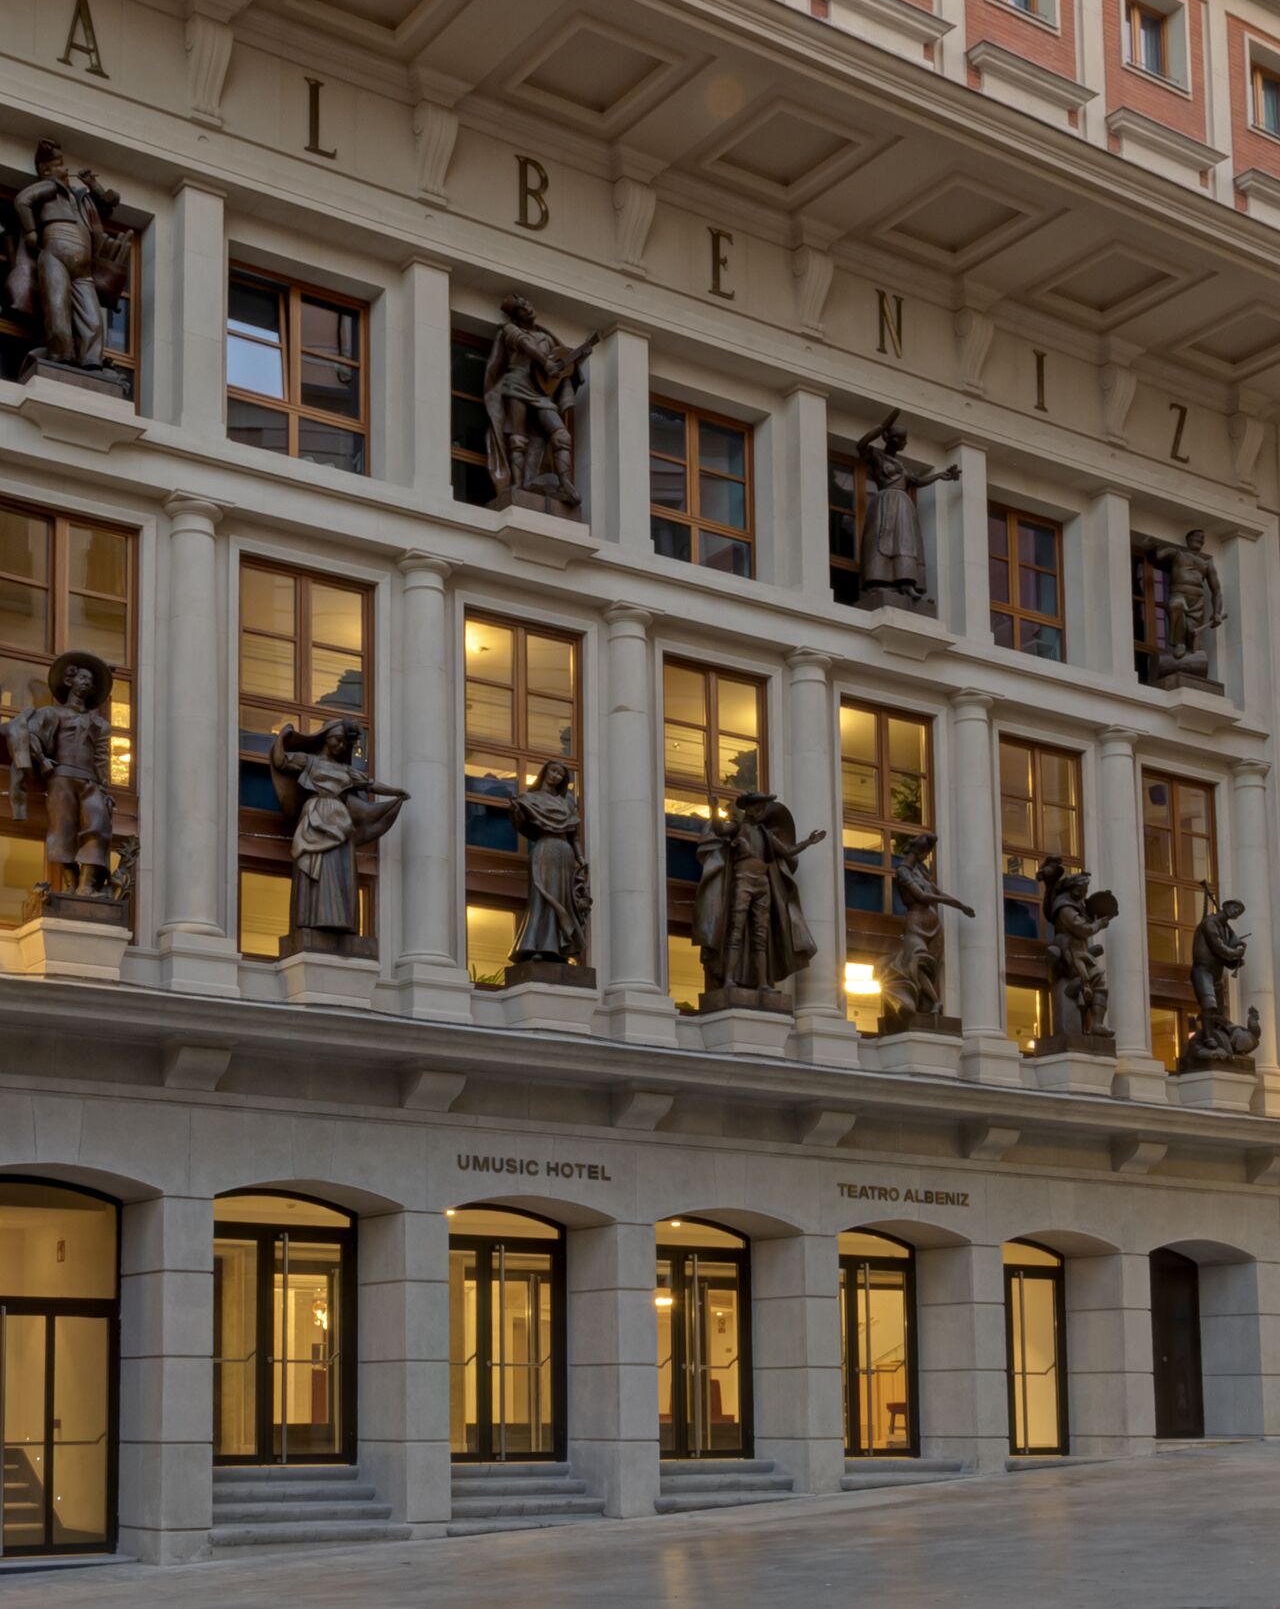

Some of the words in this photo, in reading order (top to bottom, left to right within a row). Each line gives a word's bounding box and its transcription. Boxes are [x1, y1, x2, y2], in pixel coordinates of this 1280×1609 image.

[457, 1154, 539, 1176] UMUSIC
[546, 1161, 611, 1181] HOTEL
[836, 1182, 900, 1202] TEATRO
[904, 1188, 969, 1207] ALBENIZ
